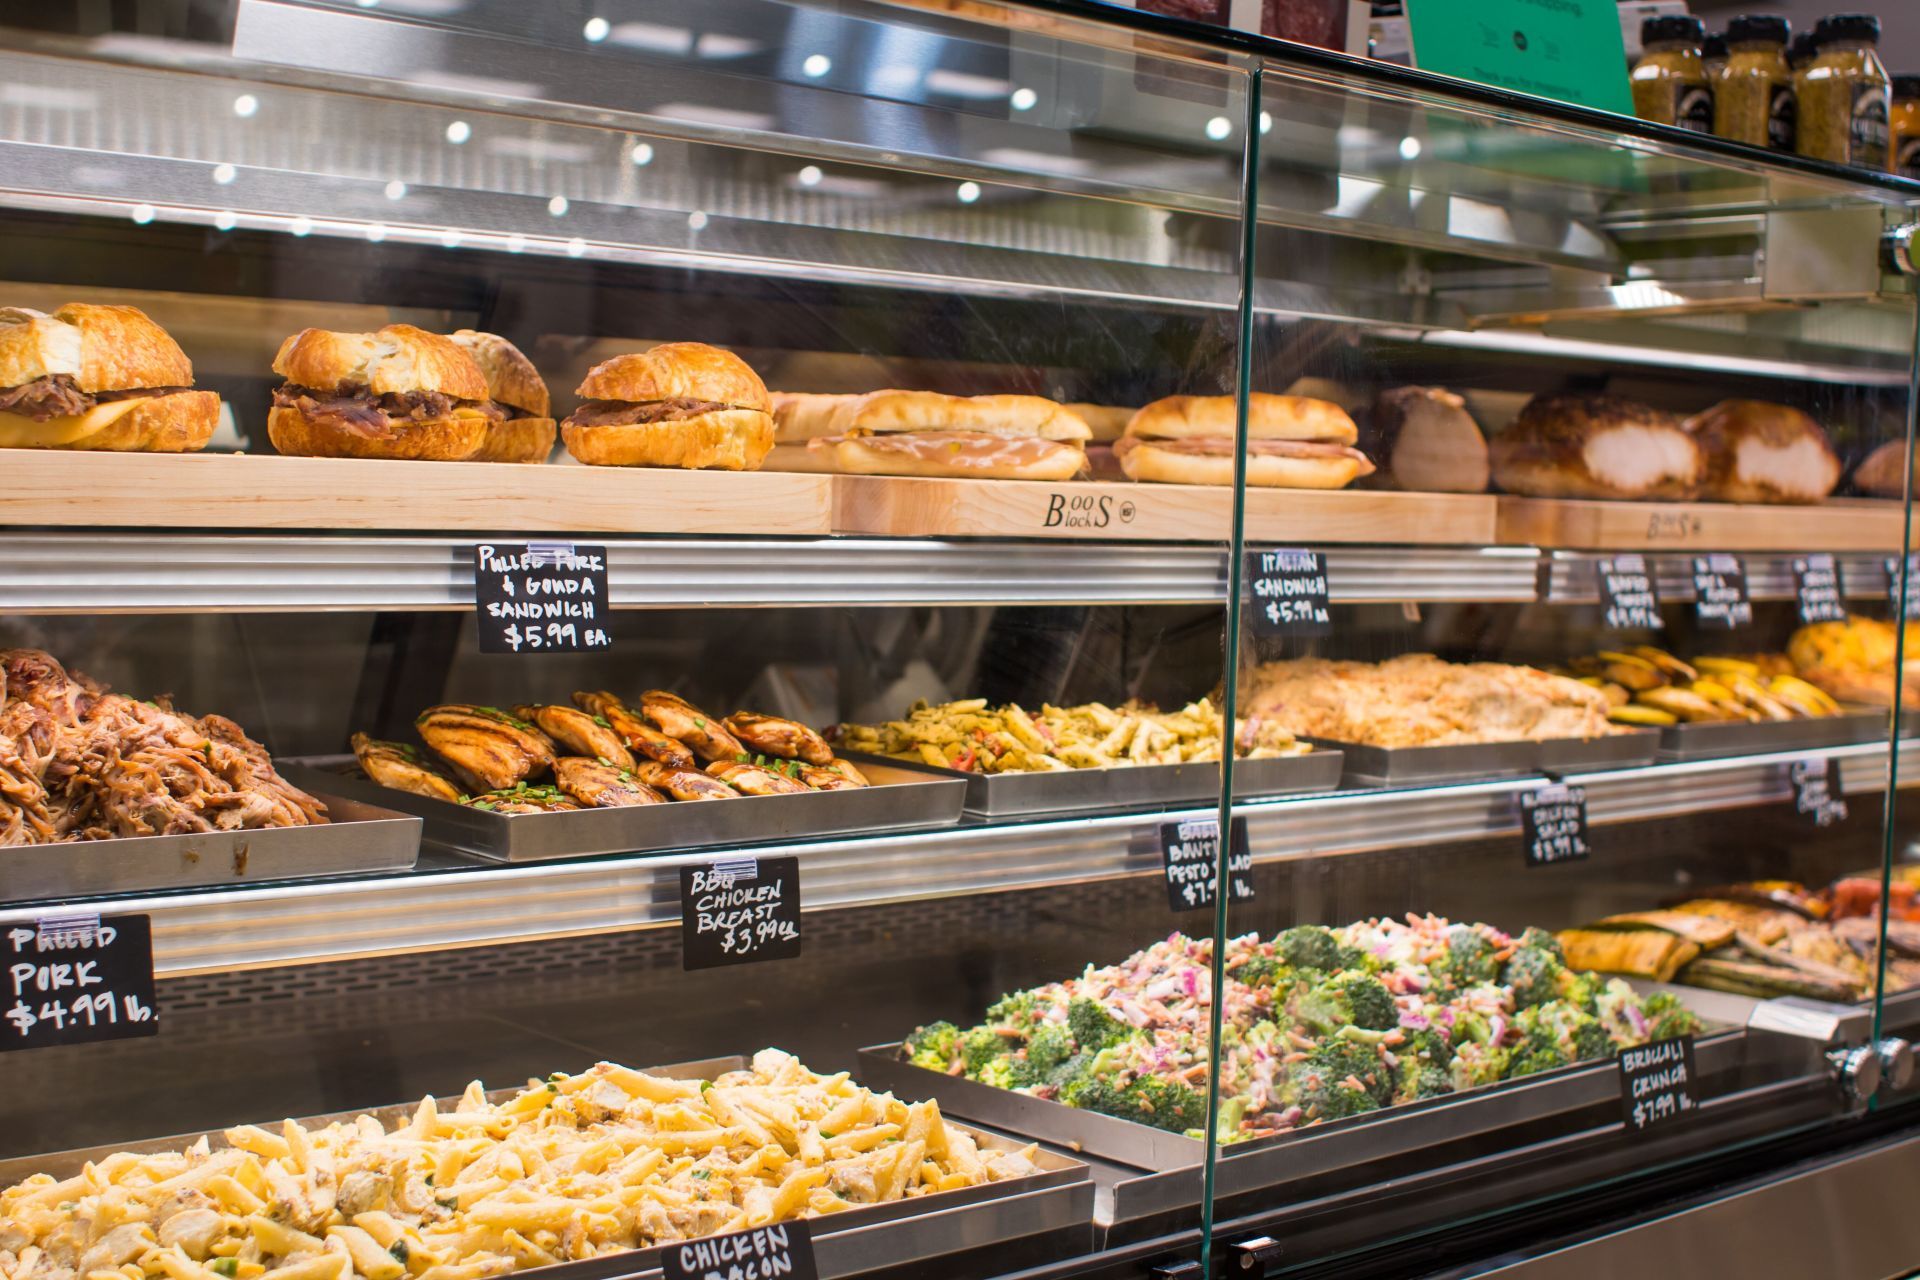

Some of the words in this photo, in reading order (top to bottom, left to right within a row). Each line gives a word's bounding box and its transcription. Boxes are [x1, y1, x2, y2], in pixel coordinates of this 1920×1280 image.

[1254, 576, 1326, 597] SANDWICH
[486, 600, 594, 620] SANDWICH
[1266, 600, 1313, 625] $5.99
[503, 623, 577, 652] $5.99
[1168, 862, 1209, 884] PESTO
[696, 878, 782, 912] CHICKEN
[697, 901, 782, 934] BREAST
[10, 960, 103, 996] PORK
[5, 990, 117, 1036] $4.99
[1632, 1062, 1687, 1098] CRUNCH
[1633, 1092, 1676, 1129] $7.99
[680, 1223, 789, 1273] CHICKEN
